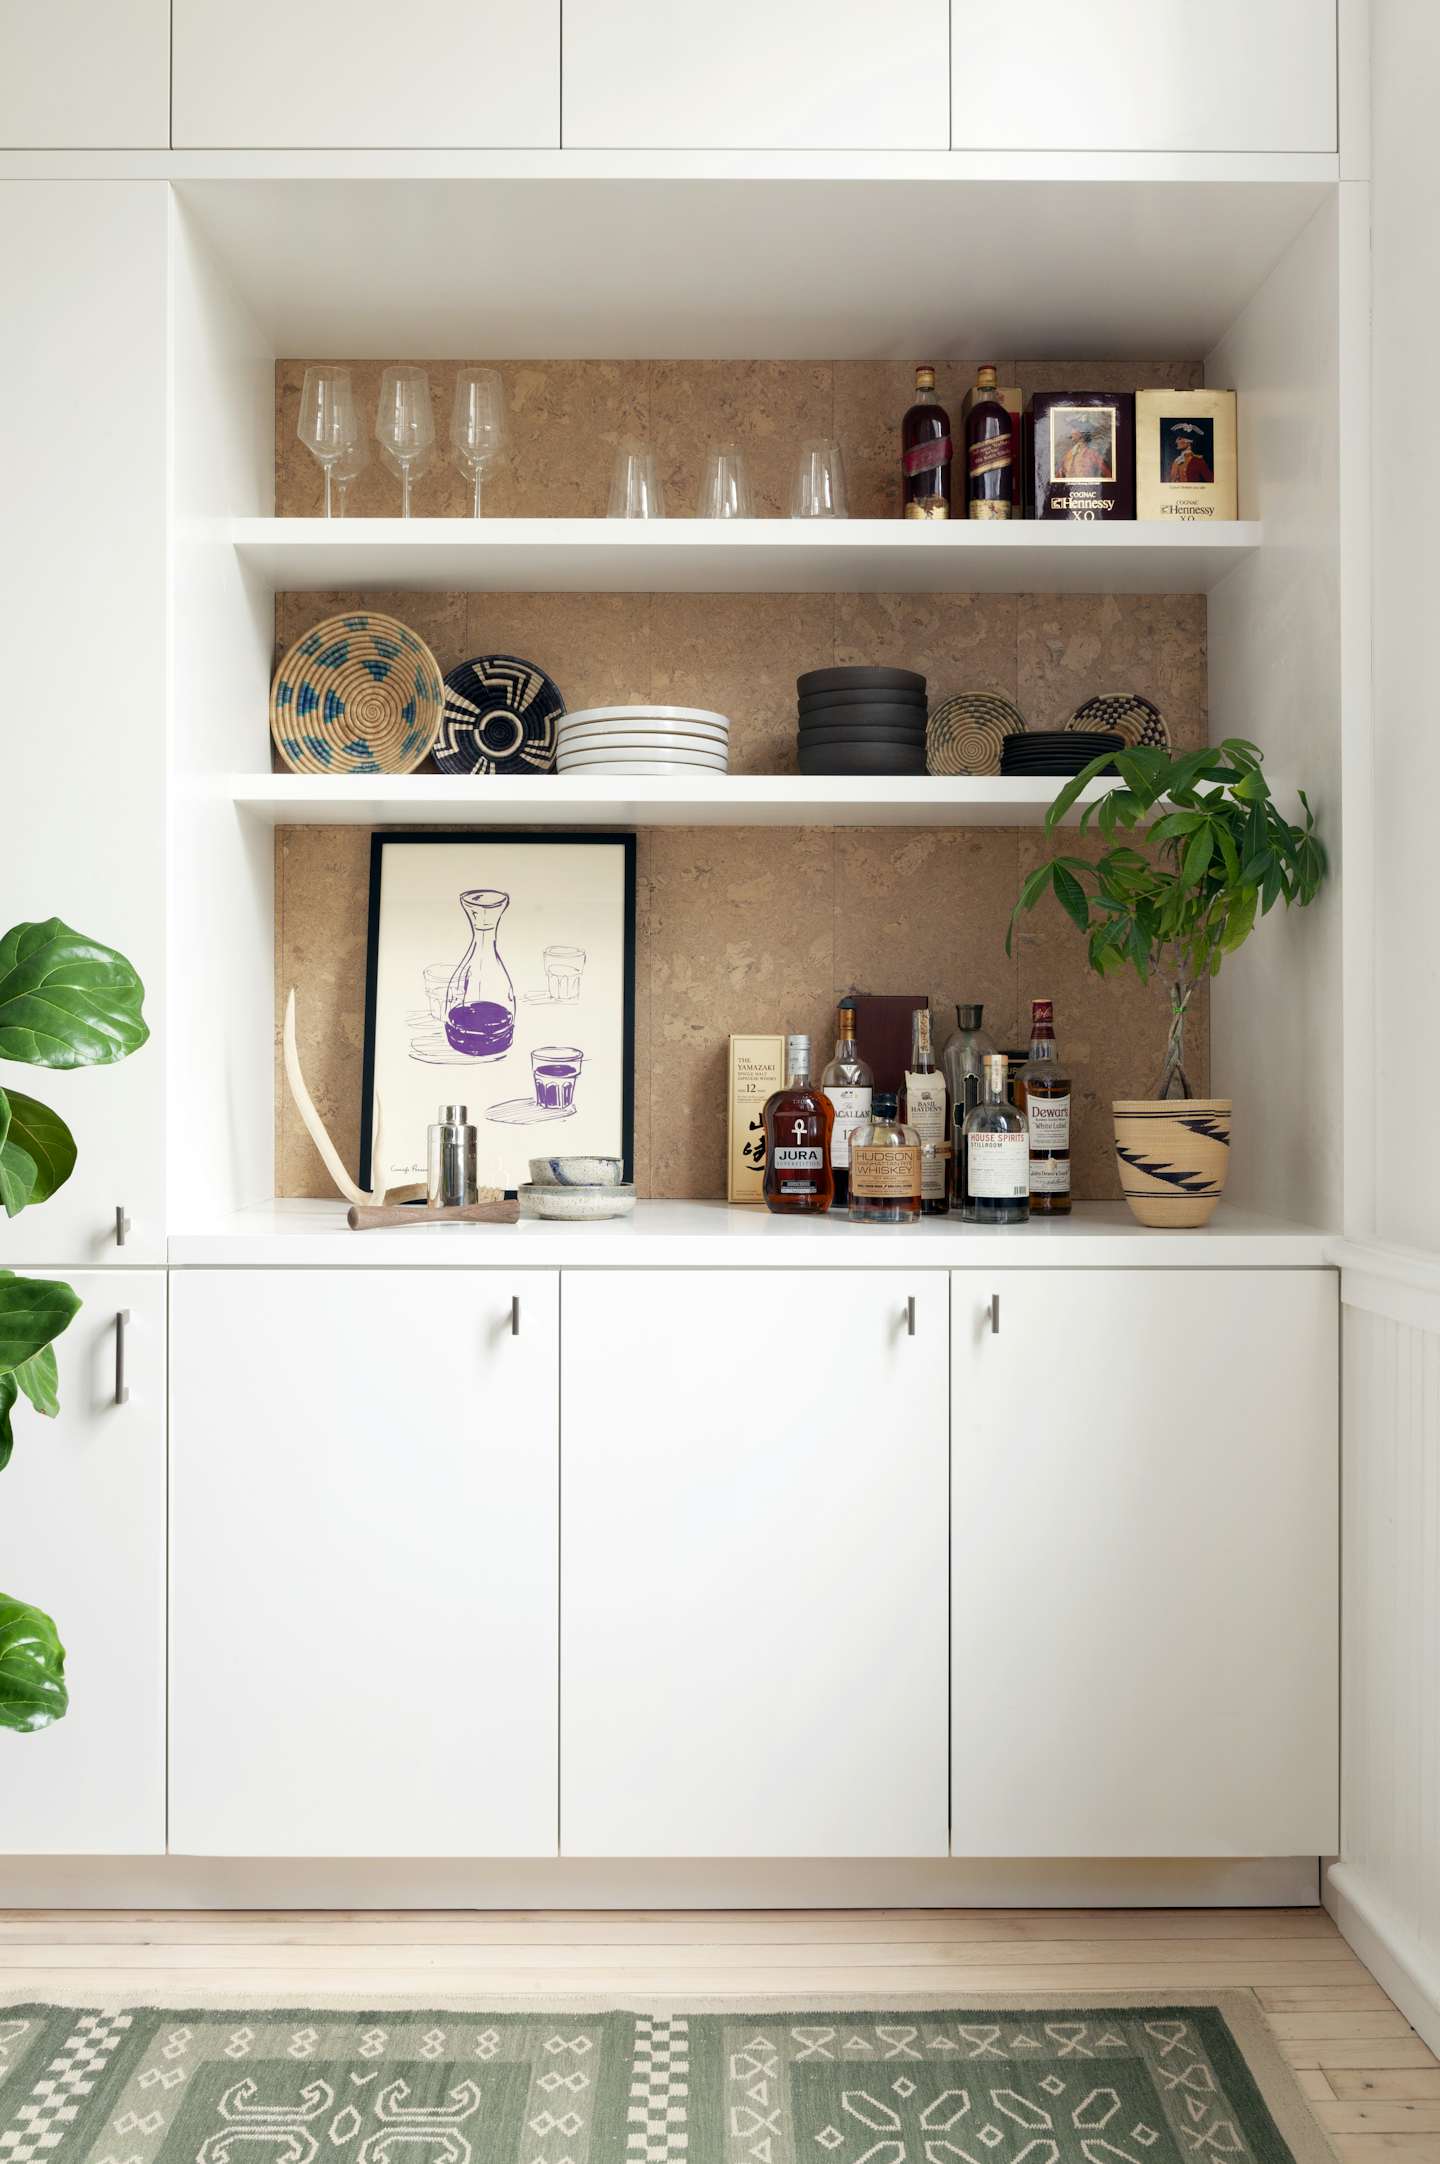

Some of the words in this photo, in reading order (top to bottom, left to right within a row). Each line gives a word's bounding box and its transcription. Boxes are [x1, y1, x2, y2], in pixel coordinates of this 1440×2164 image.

[1063, 497, 1115, 511] Hennessy
[1169, 505, 1215, 516] Hennessy
[746, 1083, 757, 1093] 12
[970, 1133, 994, 1142] HOUSE
[997, 1133, 1025, 1142] SPIRITS
[779, 1150, 817, 1160] JURA
[856, 1152, 913, 1161] HUDSON
[857, 1166, 913, 1175] WHISKEY
